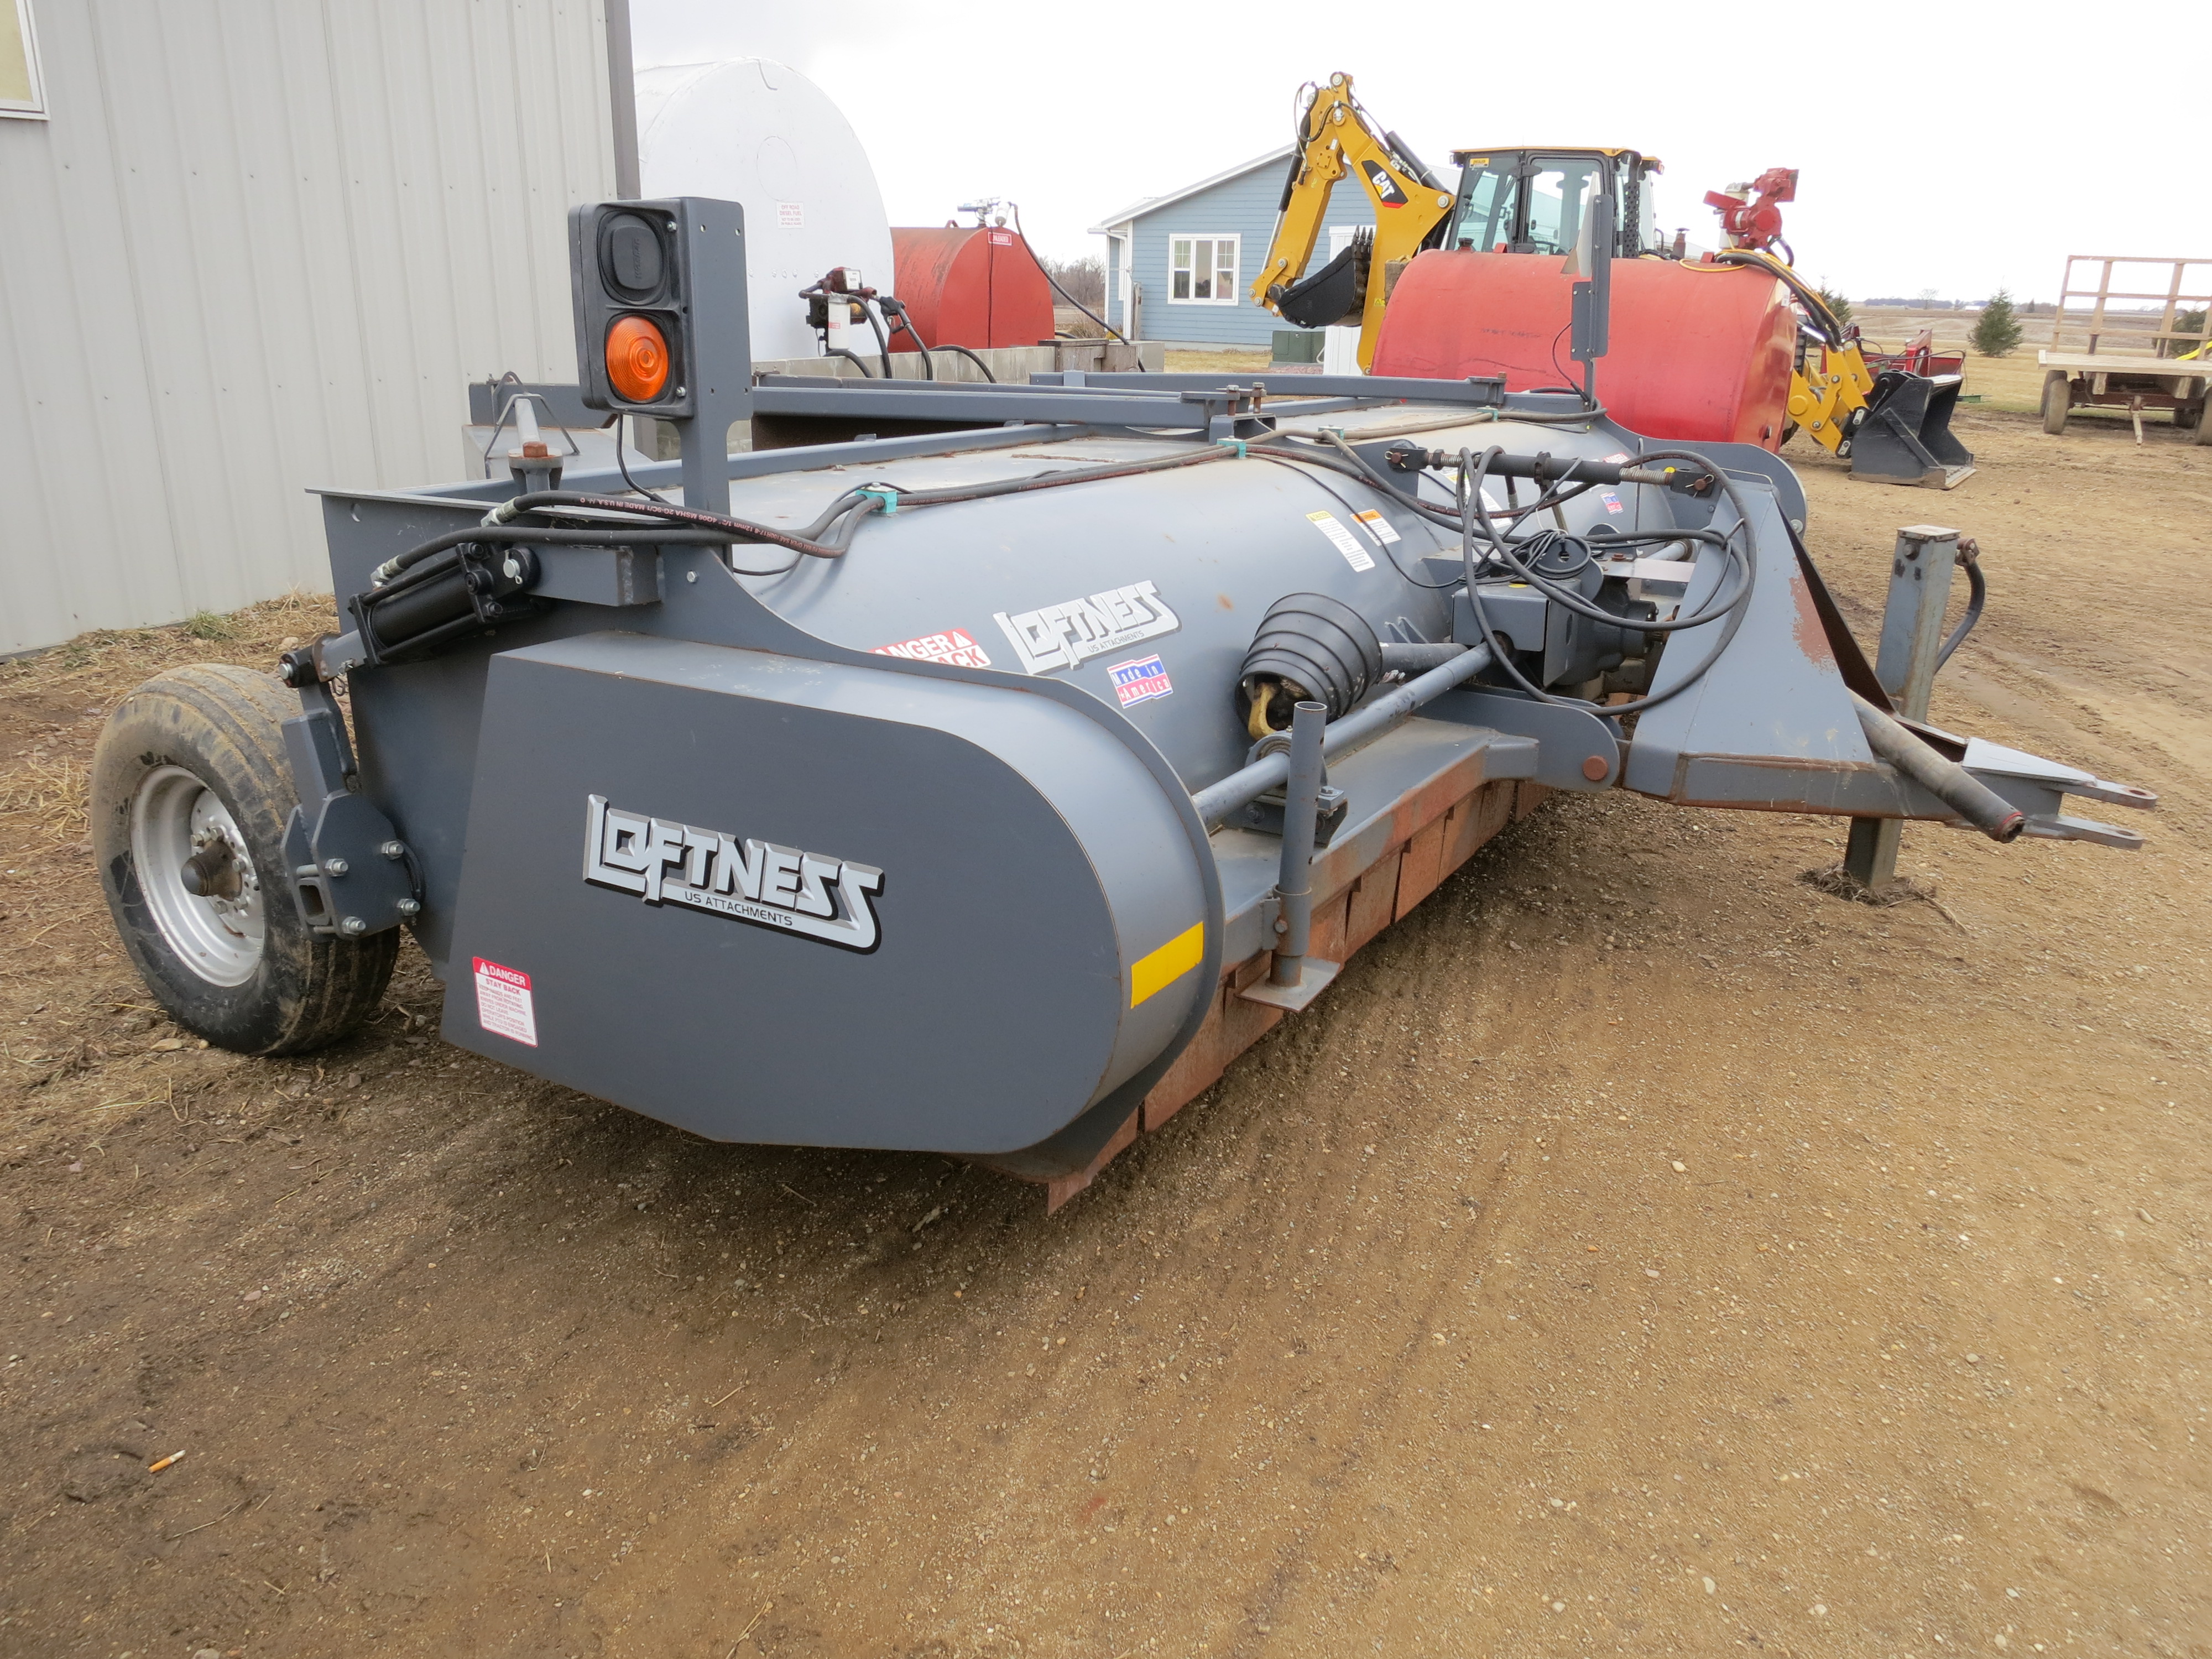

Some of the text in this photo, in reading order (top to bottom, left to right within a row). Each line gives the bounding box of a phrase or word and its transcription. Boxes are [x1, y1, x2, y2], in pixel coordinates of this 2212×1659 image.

[1371, 170, 1395, 200] CAT
[624, 502, 645, 510] MADE
[675, 510, 697, 519] MSHA
[734, 522, 753, 531] 12mm
[993, 580, 1183, 675] LOFTNESS
[1087, 630, 1145, 654] US ATTACHMENTS
[1110, 664, 1159, 686] Made in
[1123, 677, 1171, 700] America
[582, 794, 885, 955] LOFTNESS
[685, 890, 793, 926] US ATTACHMENTS
[486, 978, 520, 995] STAY BACK
[489, 965, 525, 987] DANGER
